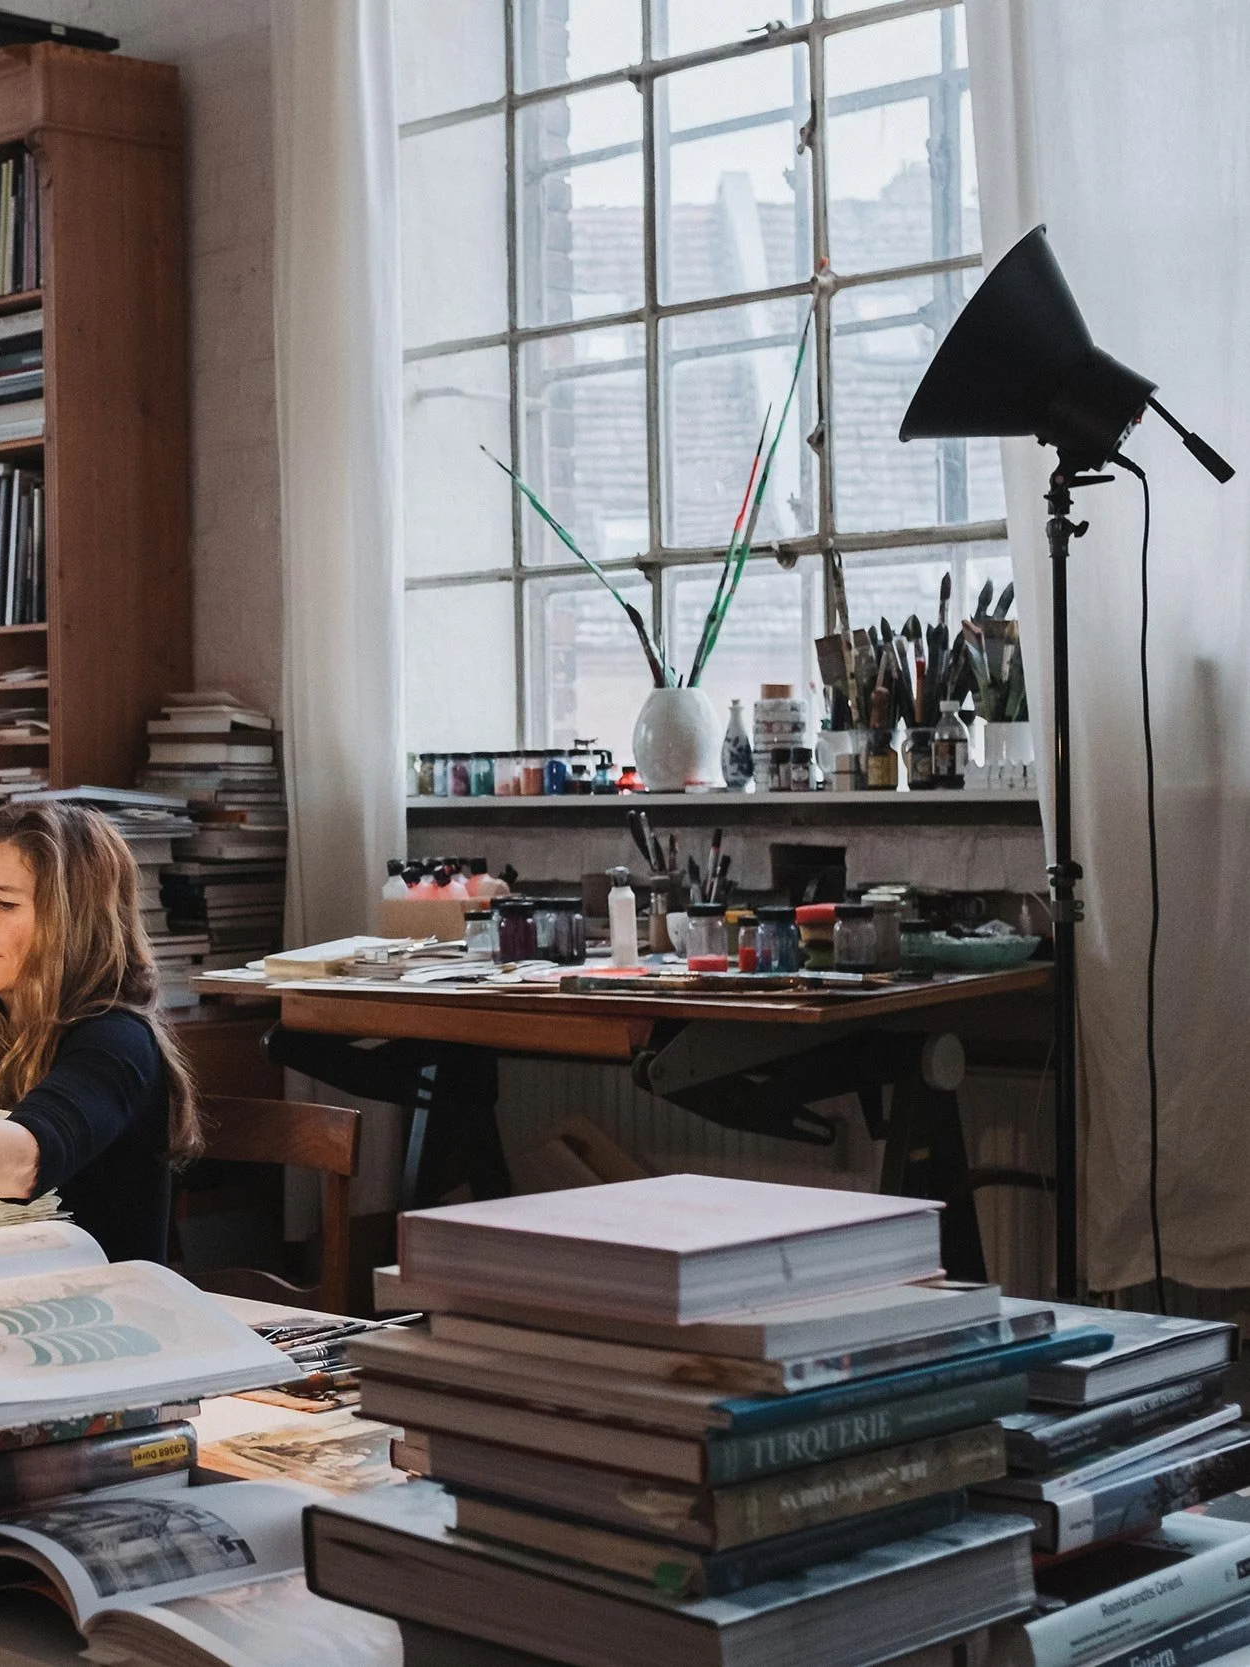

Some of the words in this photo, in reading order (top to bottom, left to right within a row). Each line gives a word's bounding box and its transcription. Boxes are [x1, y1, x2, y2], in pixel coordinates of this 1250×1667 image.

[752, 1409, 892, 1469] TURQUERIE
[1100, 1586, 1156, 1618] Rembrandts
[1155, 1572, 1184, 1595] Orient
